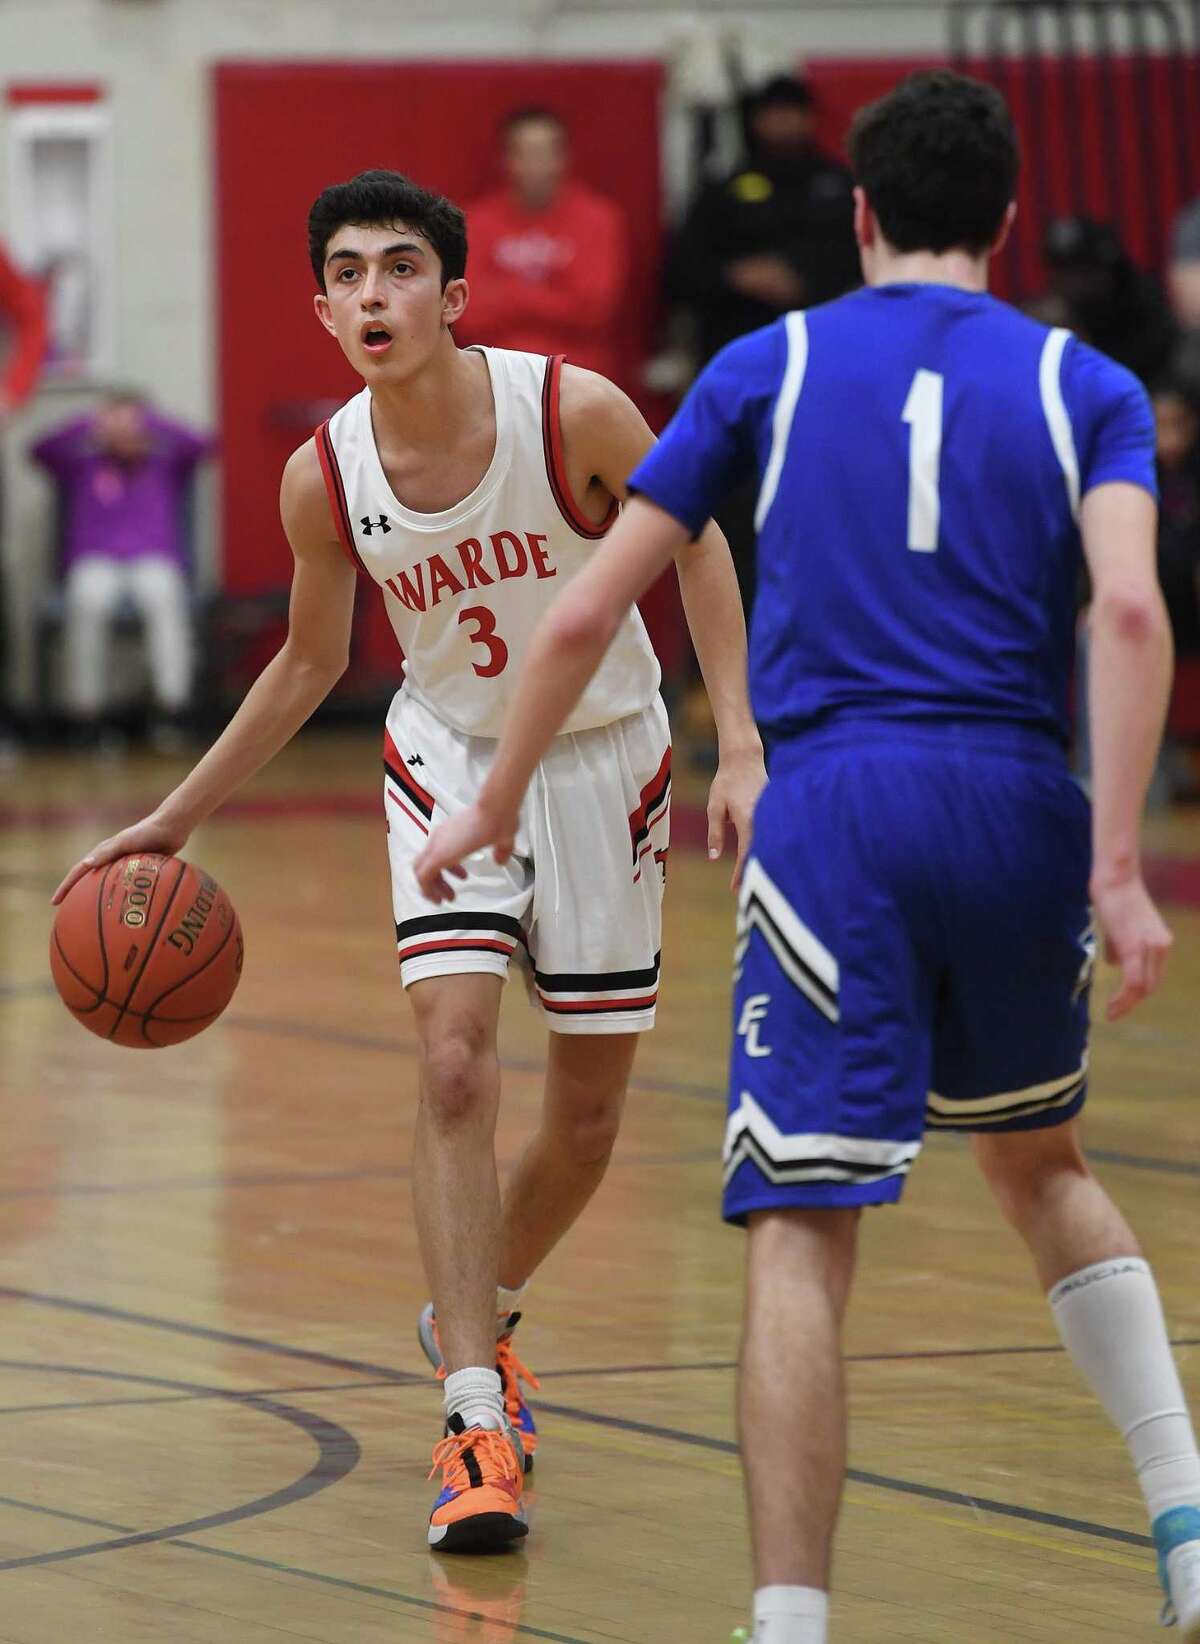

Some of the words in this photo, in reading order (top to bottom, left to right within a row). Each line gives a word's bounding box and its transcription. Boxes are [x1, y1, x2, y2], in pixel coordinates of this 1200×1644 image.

[900, 368, 945, 554] 1
[384, 530, 557, 612] WARDE
[458, 605, 509, 678] 3
